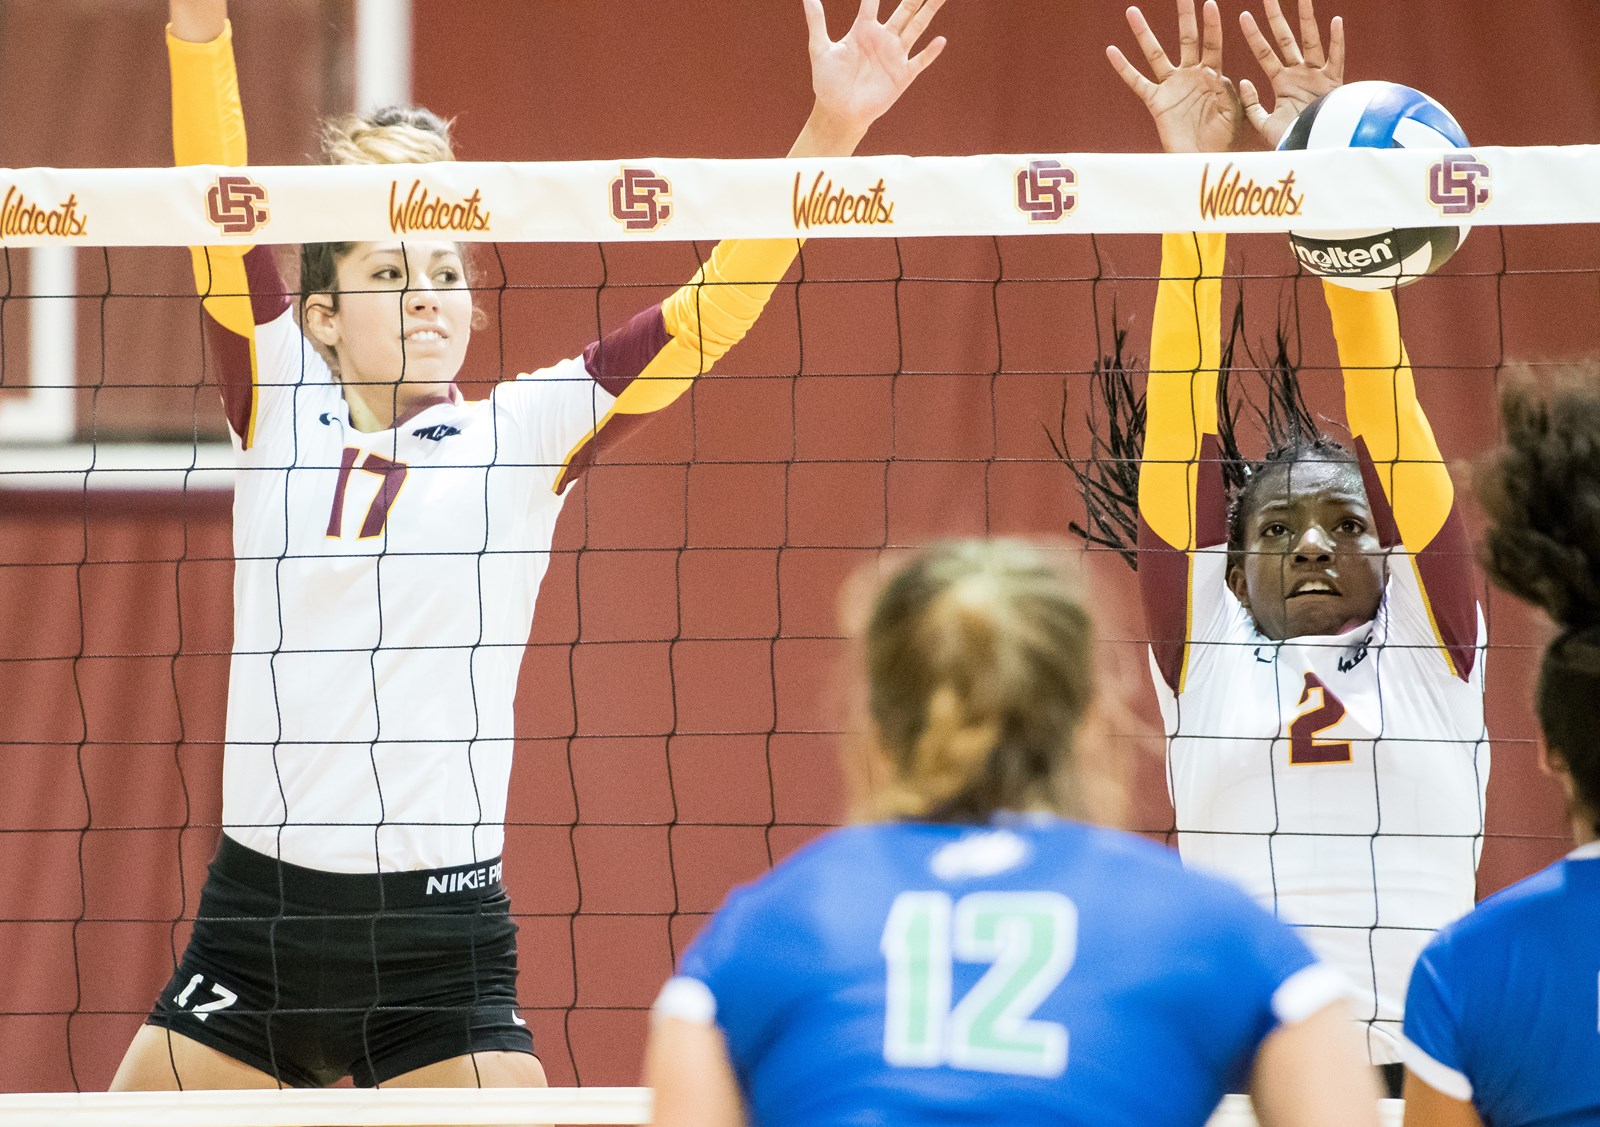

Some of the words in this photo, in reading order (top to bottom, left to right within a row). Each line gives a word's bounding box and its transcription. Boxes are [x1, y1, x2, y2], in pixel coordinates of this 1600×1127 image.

[389, 178, 490, 234] Wildcats
[793, 170, 894, 230] Wildcats
[1200, 161, 1304, 222] Wildcats
[325, 446, 408, 540] 17
[1287, 670, 1353, 766] 2
[425, 867, 486, 895] NIKE
[172, 973, 238, 1022] 17
[880, 889, 1079, 1080] 12
